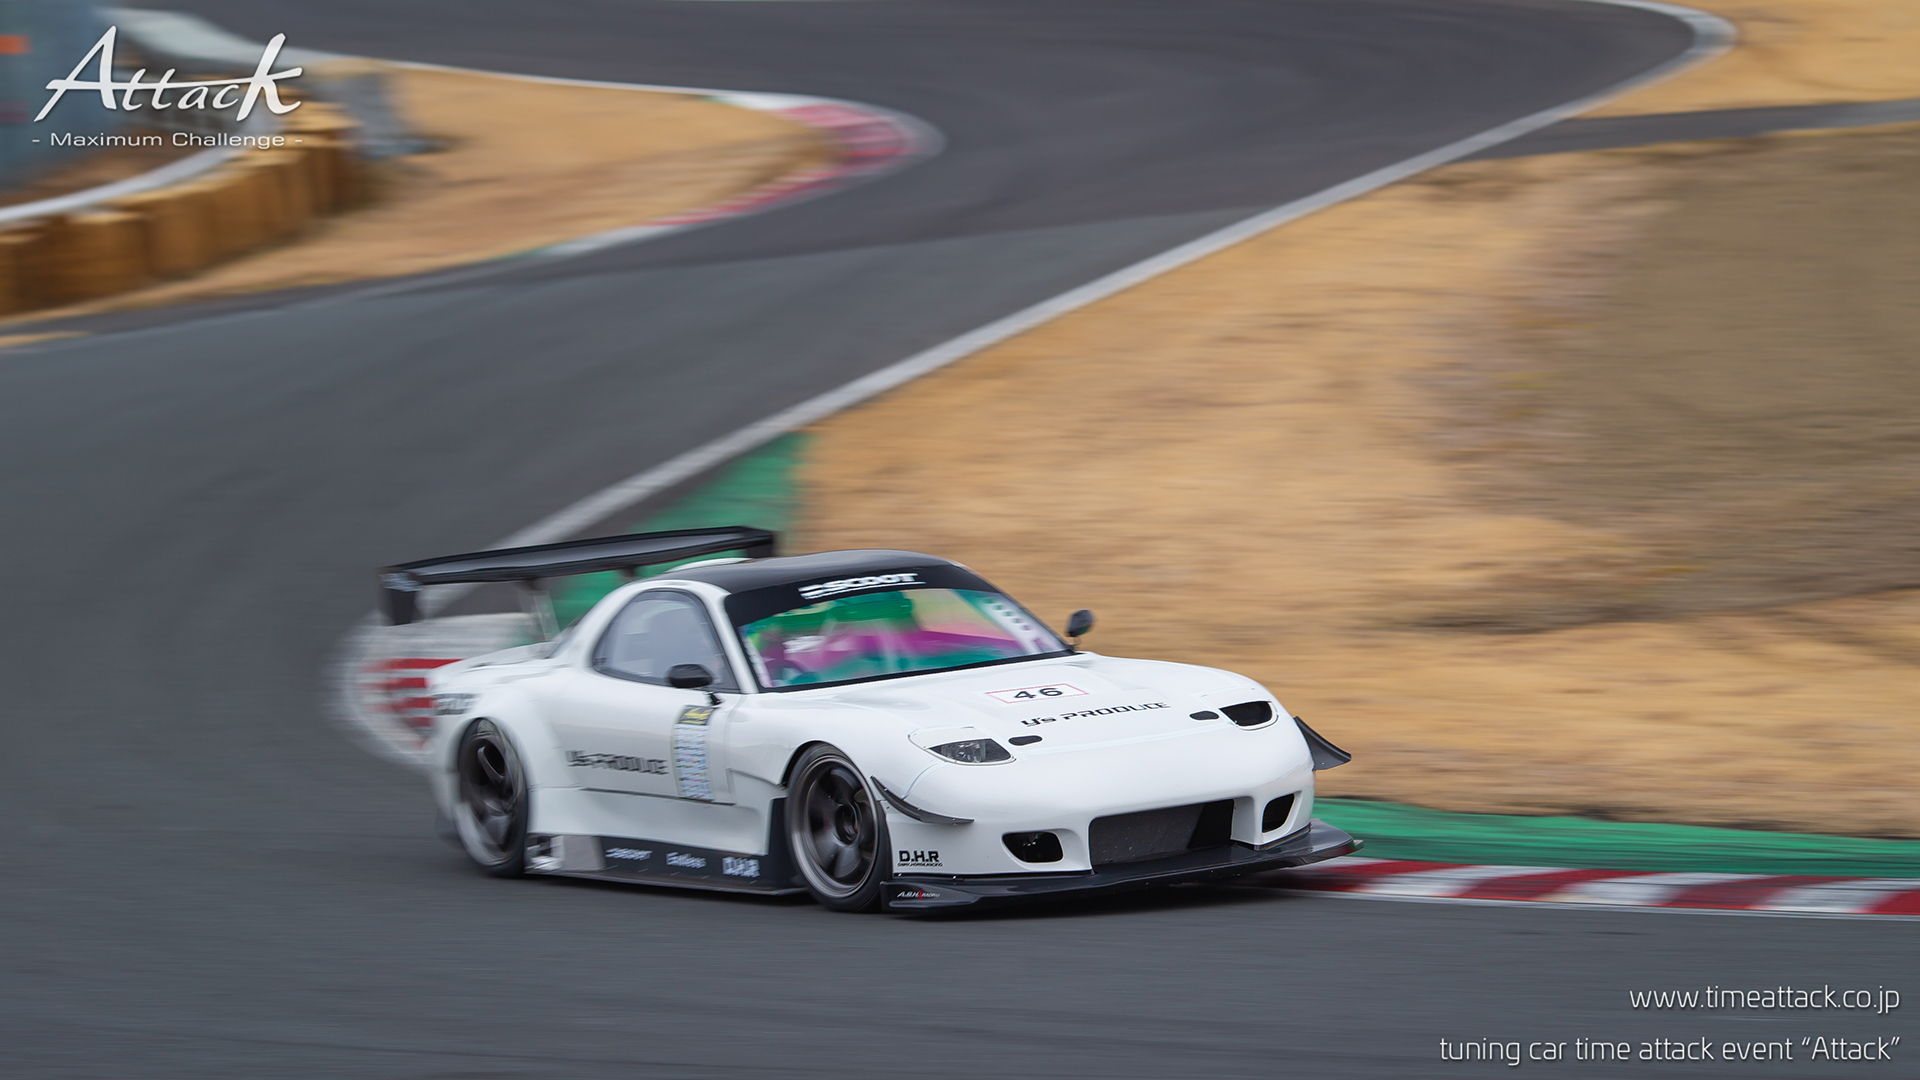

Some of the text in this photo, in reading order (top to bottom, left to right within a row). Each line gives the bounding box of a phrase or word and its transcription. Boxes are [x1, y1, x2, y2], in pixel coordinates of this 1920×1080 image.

[1013, 687, 1064, 699] 46
[1059, 702, 1171, 720] PRODUCE
[898, 850, 940, 863] D.H.R
